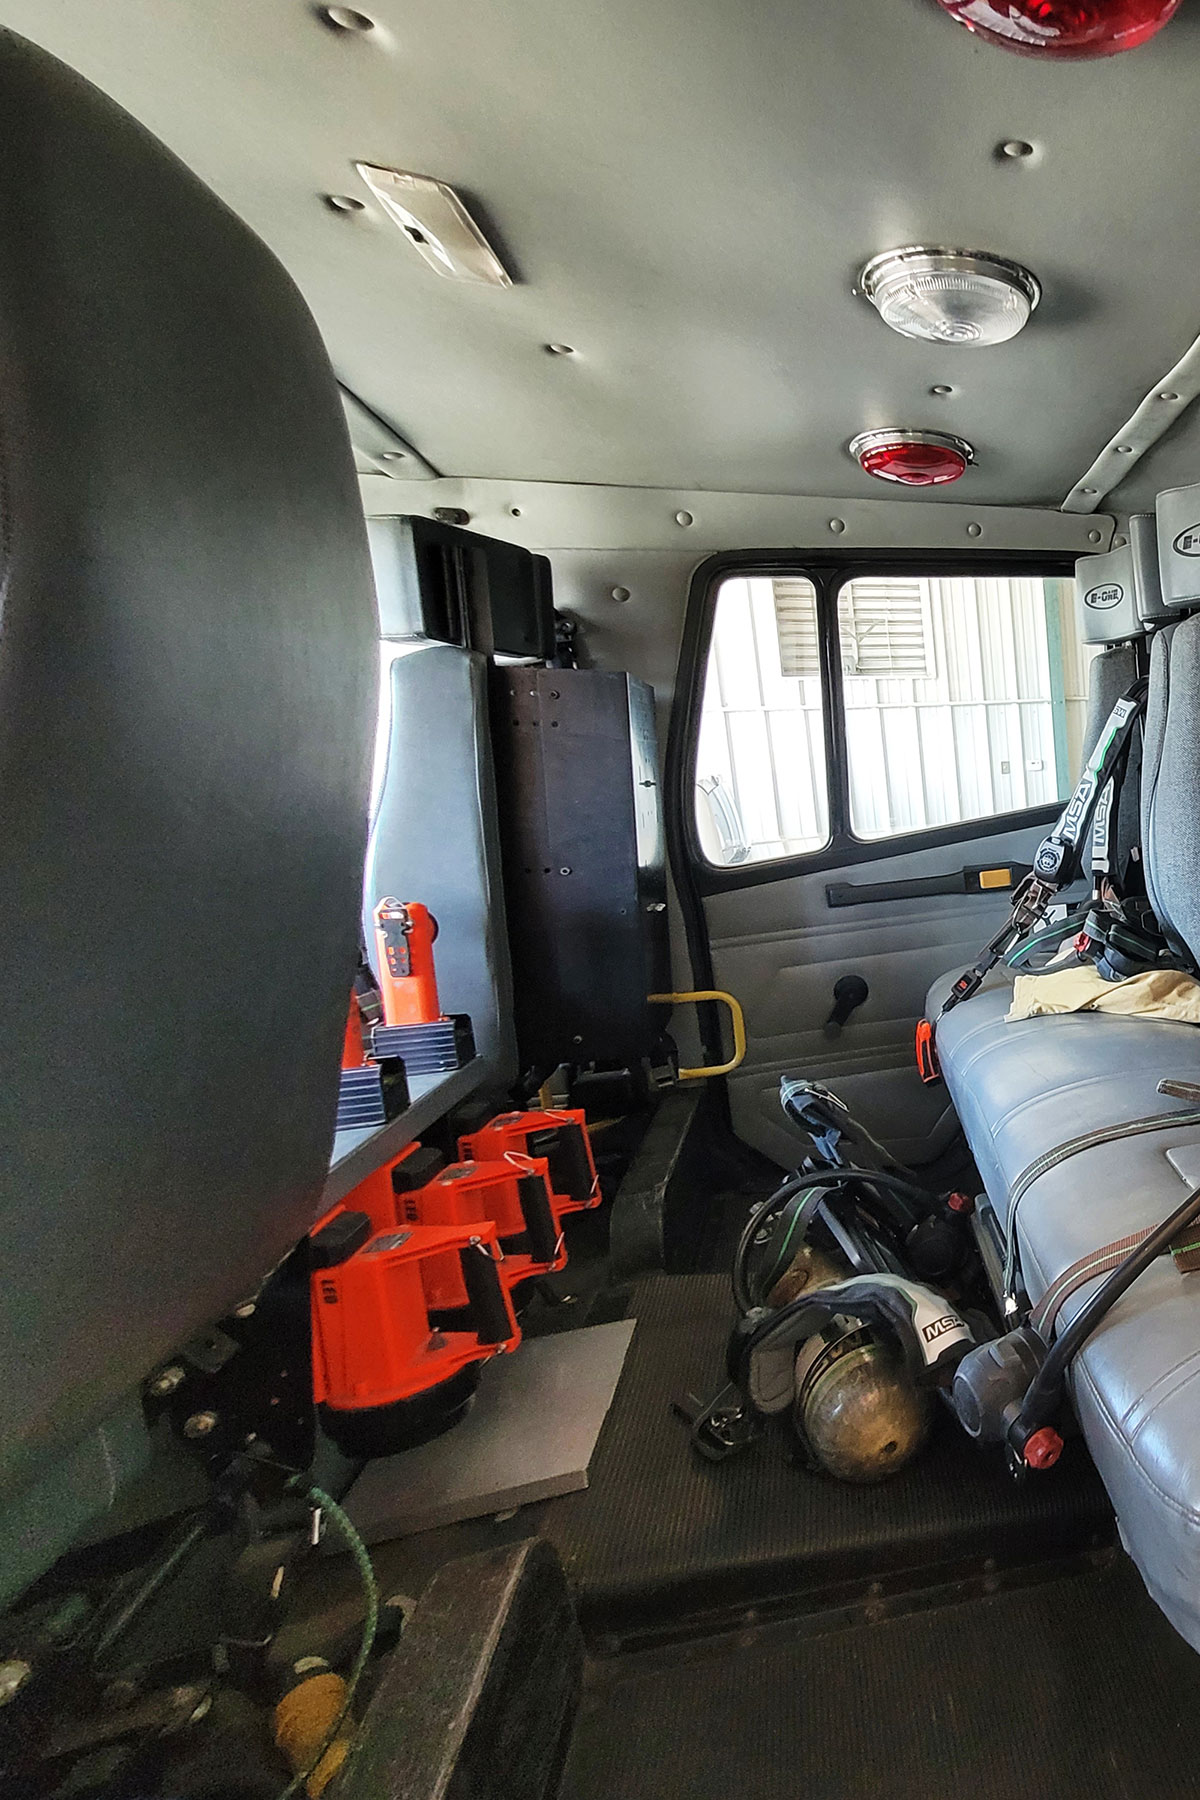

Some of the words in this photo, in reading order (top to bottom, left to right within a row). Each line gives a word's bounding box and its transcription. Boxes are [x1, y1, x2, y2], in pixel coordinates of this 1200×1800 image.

[1062, 783, 1091, 841] MSA
[1093, 786, 1111, 844] MSA
[925, 1316, 965, 1341] MSA
